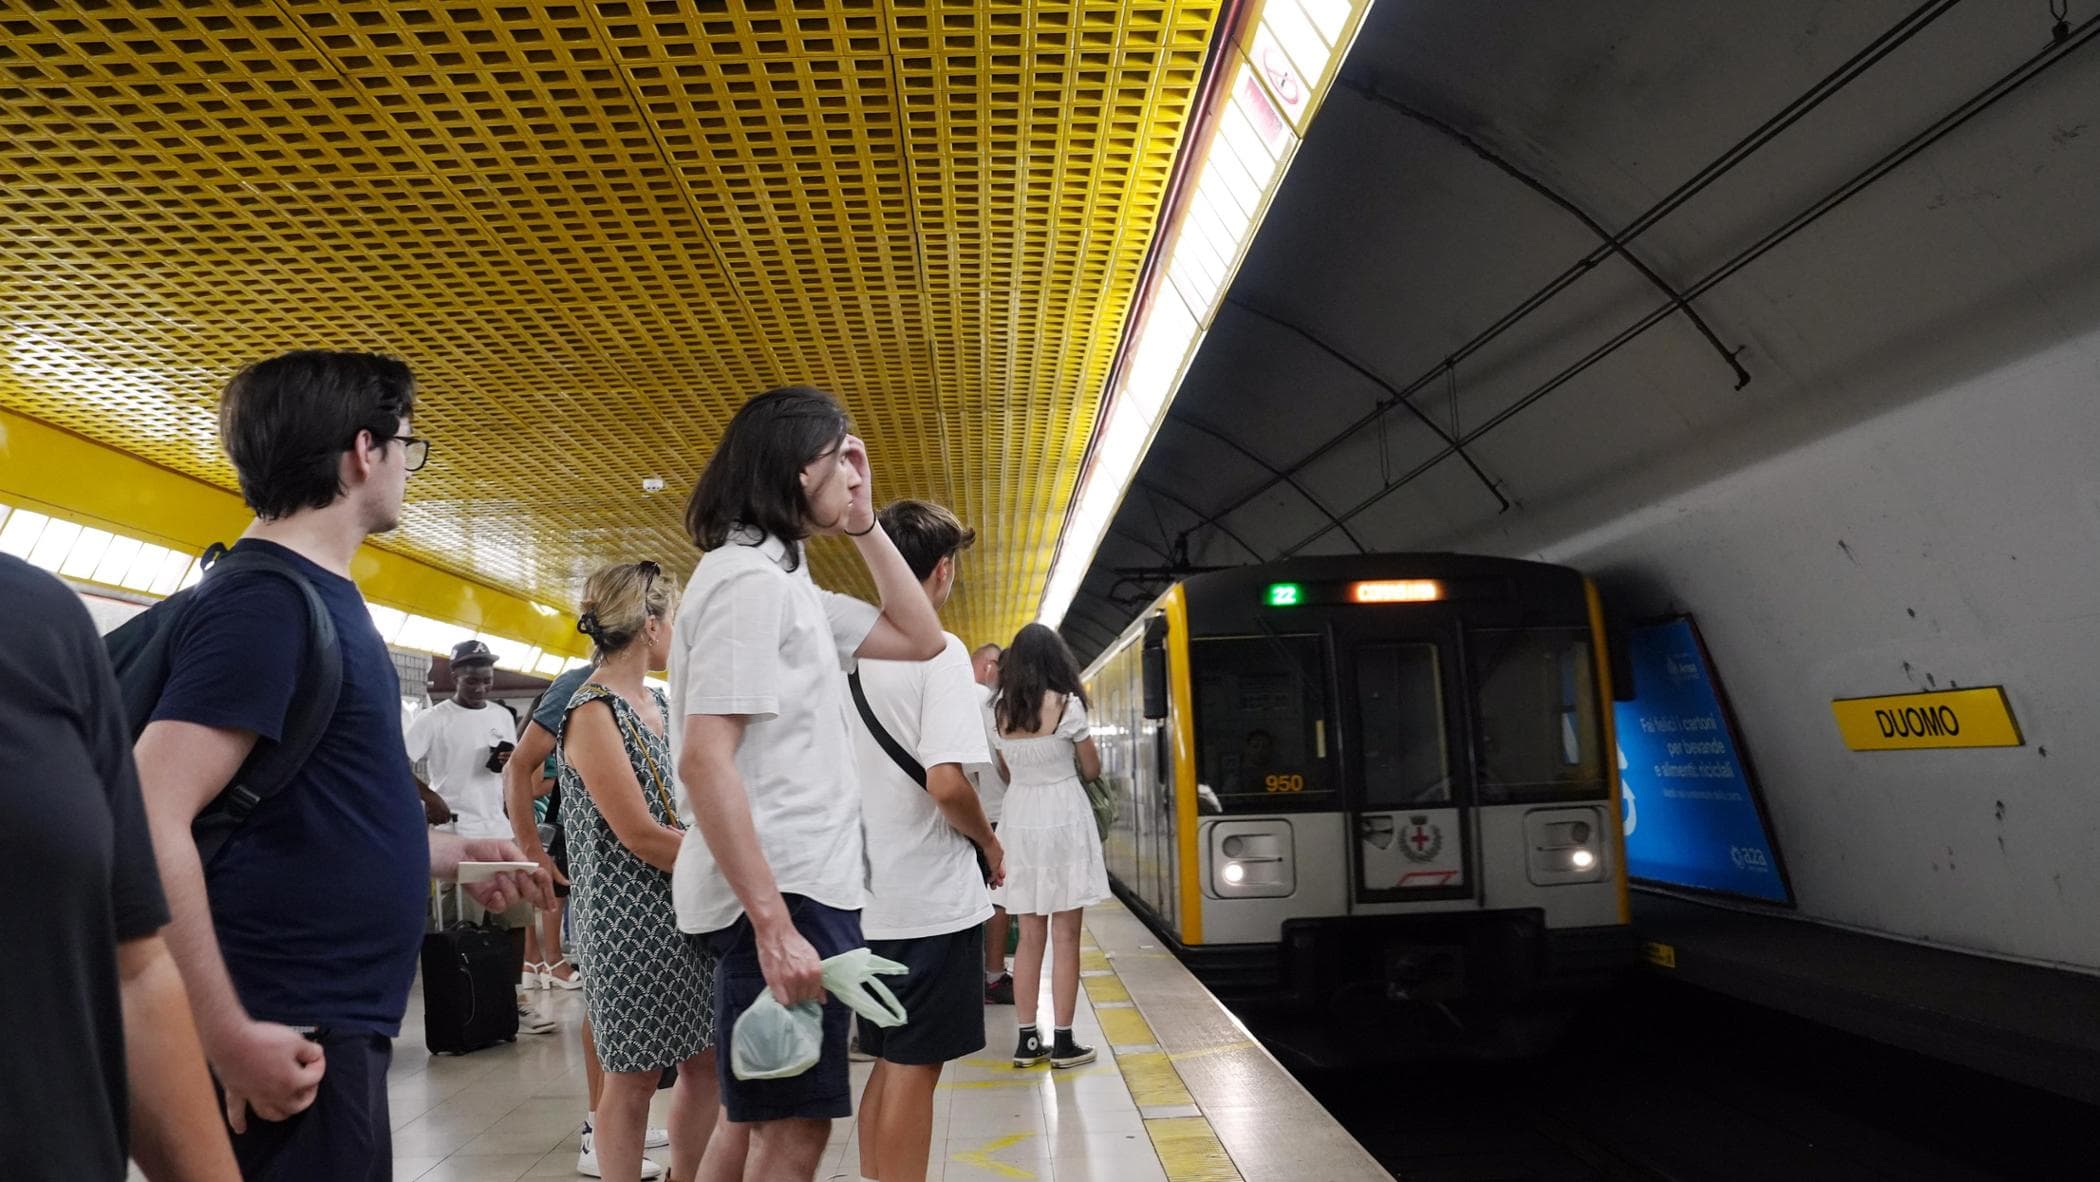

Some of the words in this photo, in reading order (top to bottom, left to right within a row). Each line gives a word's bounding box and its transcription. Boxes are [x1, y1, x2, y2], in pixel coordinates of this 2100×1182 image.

[1272, 586, 1297, 606] 22
[472, 642, 487, 654] A
[1683, 712, 1718, 731] cartoni
[1874, 705, 1960, 738] DUOMO
[1667, 741, 1682, 758] per
[1265, 774, 1304, 792] 950
